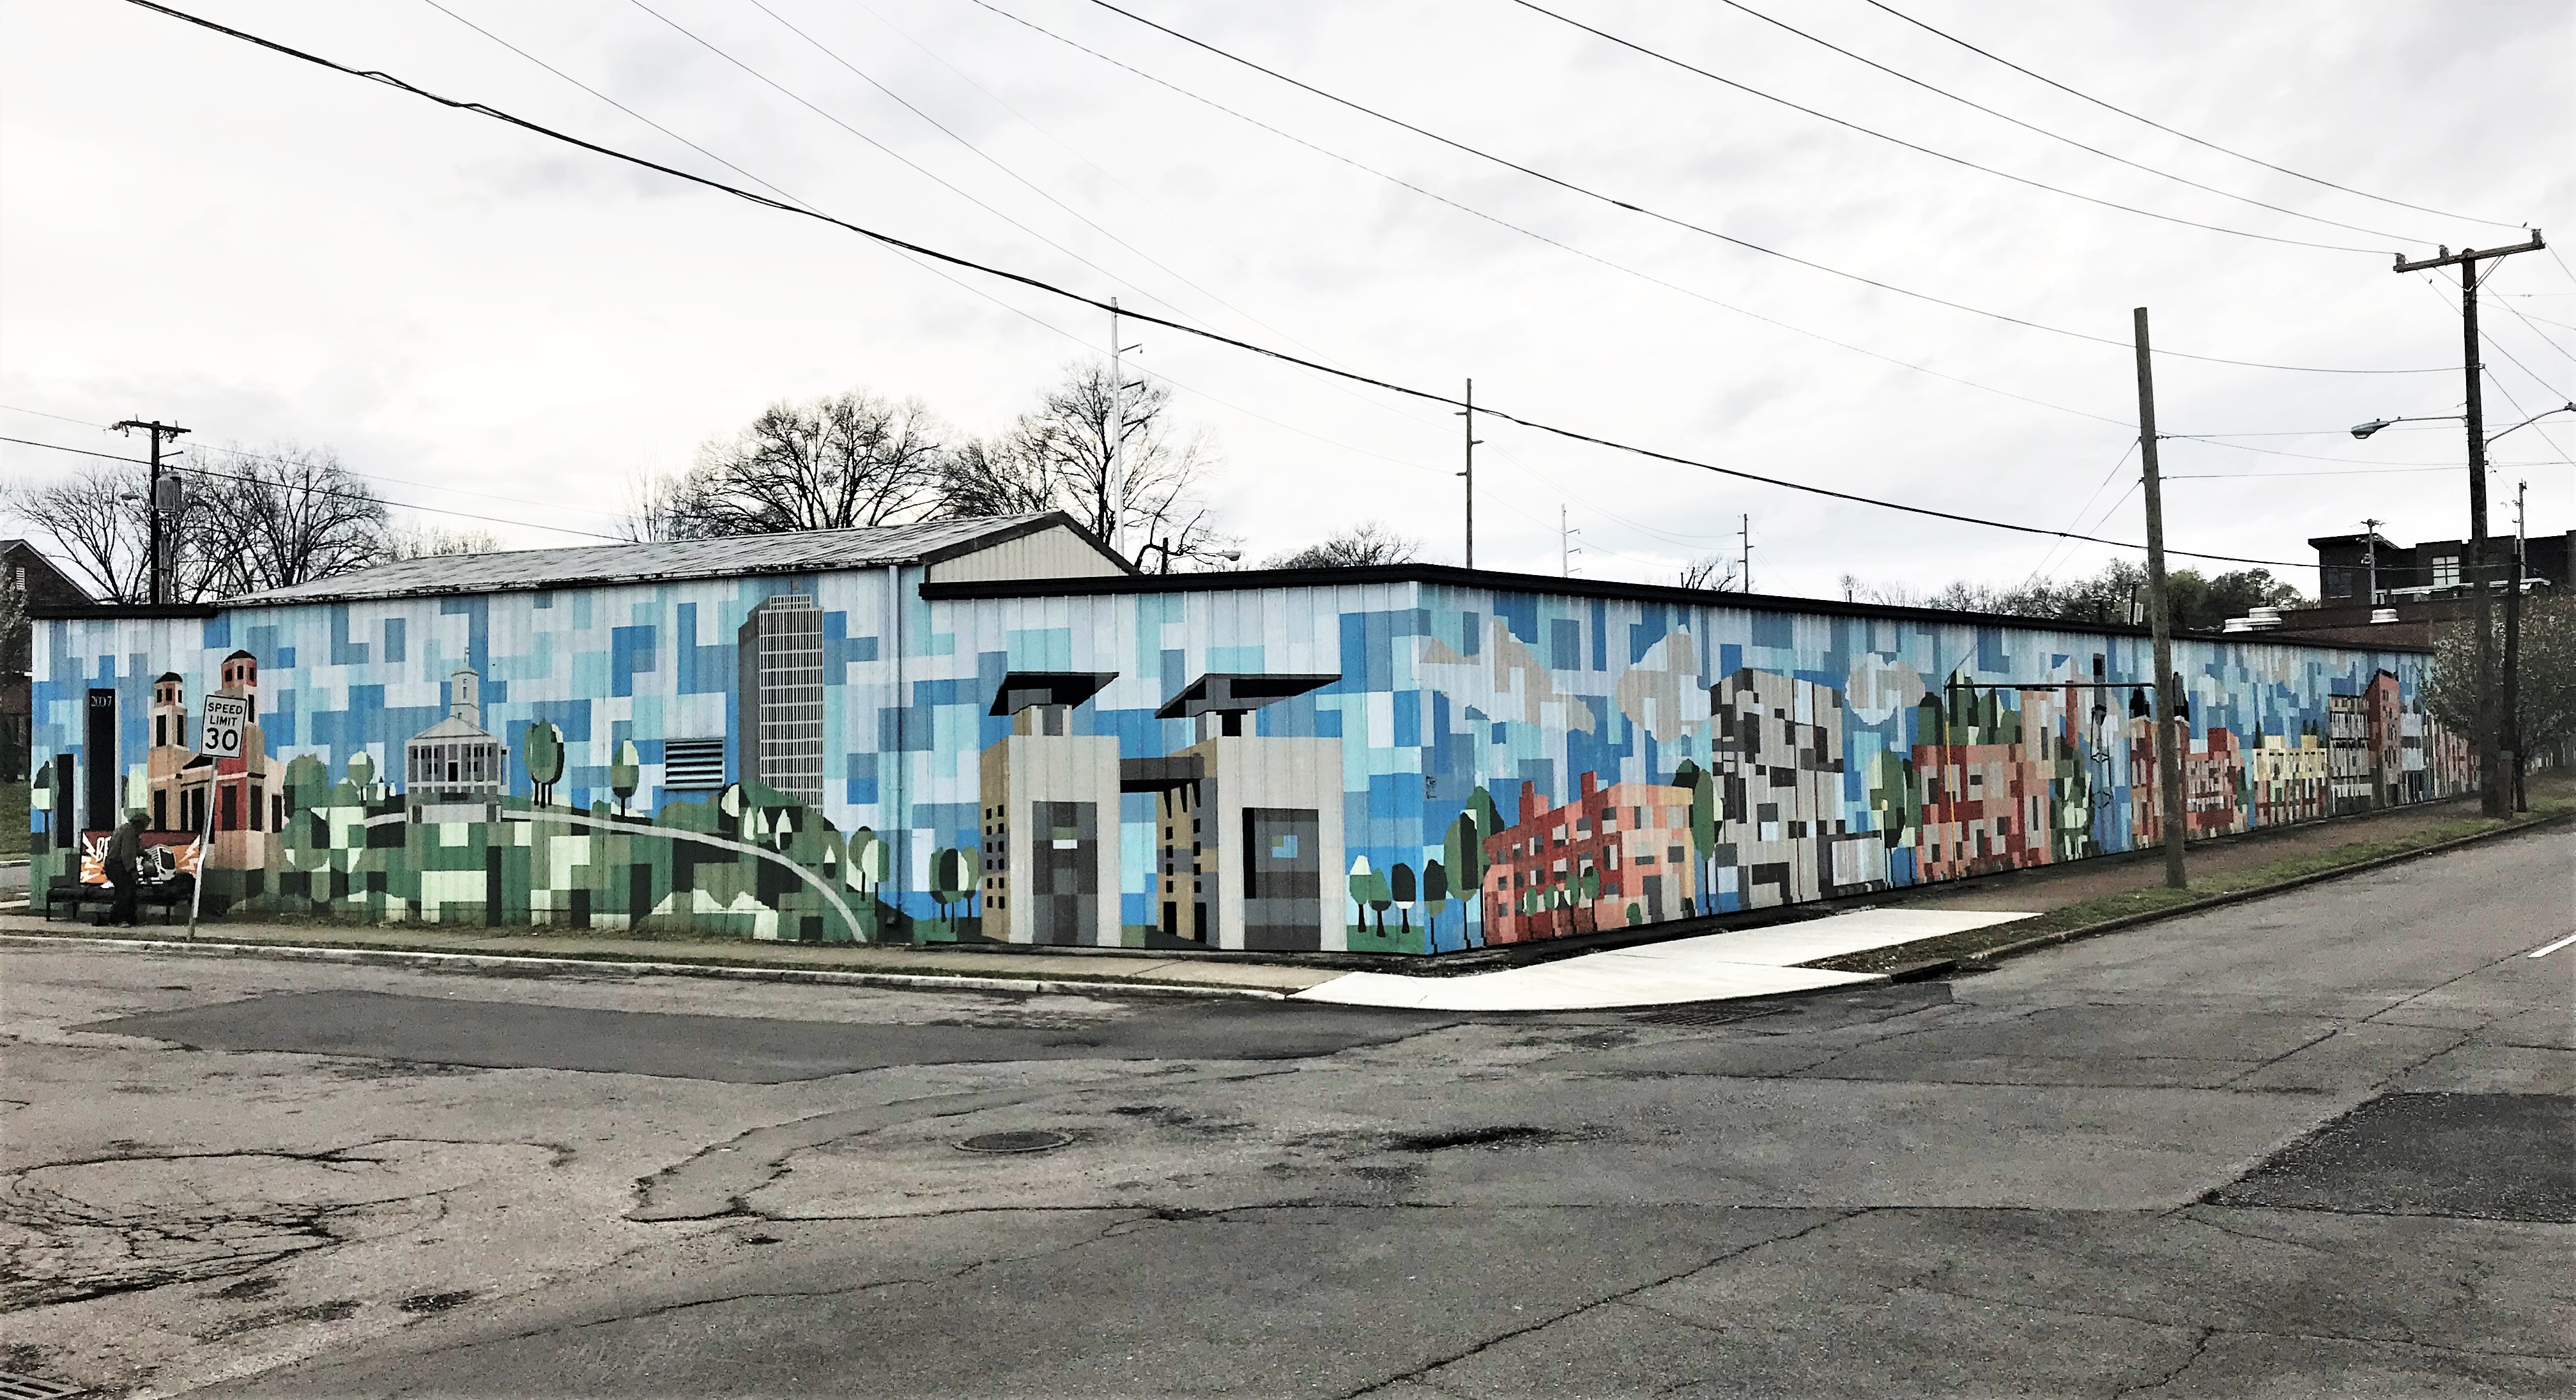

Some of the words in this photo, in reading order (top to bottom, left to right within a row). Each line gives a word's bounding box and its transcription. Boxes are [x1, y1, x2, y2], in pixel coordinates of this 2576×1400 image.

[208, 702, 243, 714] SPEED
[210, 714, 238, 727] LIMIT
[205, 727, 238, 751] 30
